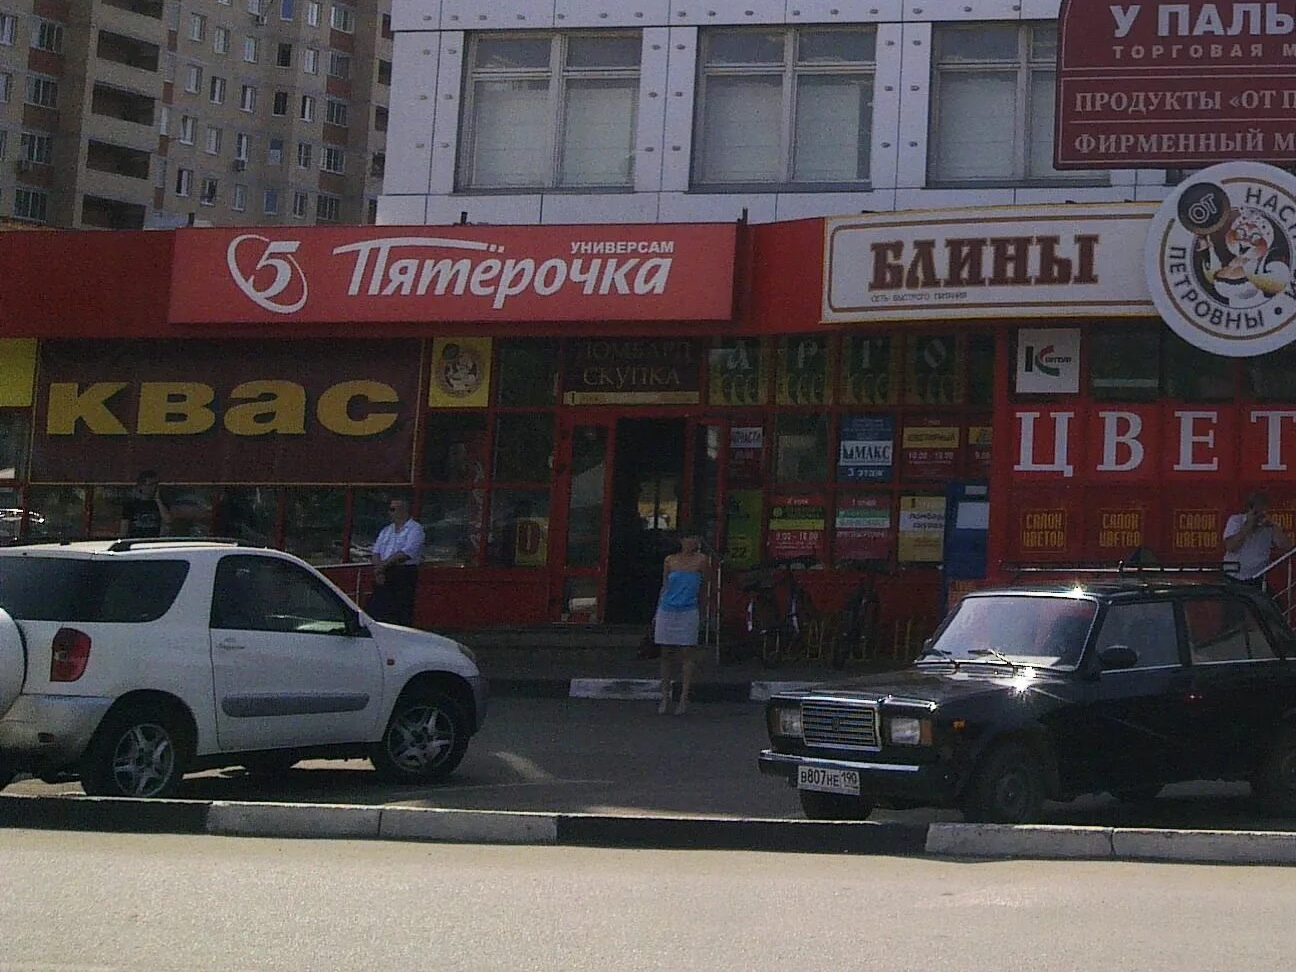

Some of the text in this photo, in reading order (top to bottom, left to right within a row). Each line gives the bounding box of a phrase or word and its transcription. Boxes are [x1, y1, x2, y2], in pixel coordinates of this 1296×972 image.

[1109, 5, 1142, 38] У
[1112, 44, 1264, 60] ТОРГОВАЯ
[1074, 91, 1223, 115] ПРОДУКТЫ
[1228, 90, 1277, 110] «ОТ
[1073, 129, 1266, 155] ФИРМЕННЫЙ
[1187, 192, 1218, 225] ОТ
[571, 240, 675, 255] УНИВЕРСАМ
[332, 236, 675, 308] Пятёрочка
[868, 234, 1100, 292] БЛИНЫ
[1168, 246, 1265, 331] ПЕТРОВНЫ
[582, 366, 681, 389] СКУПКА
